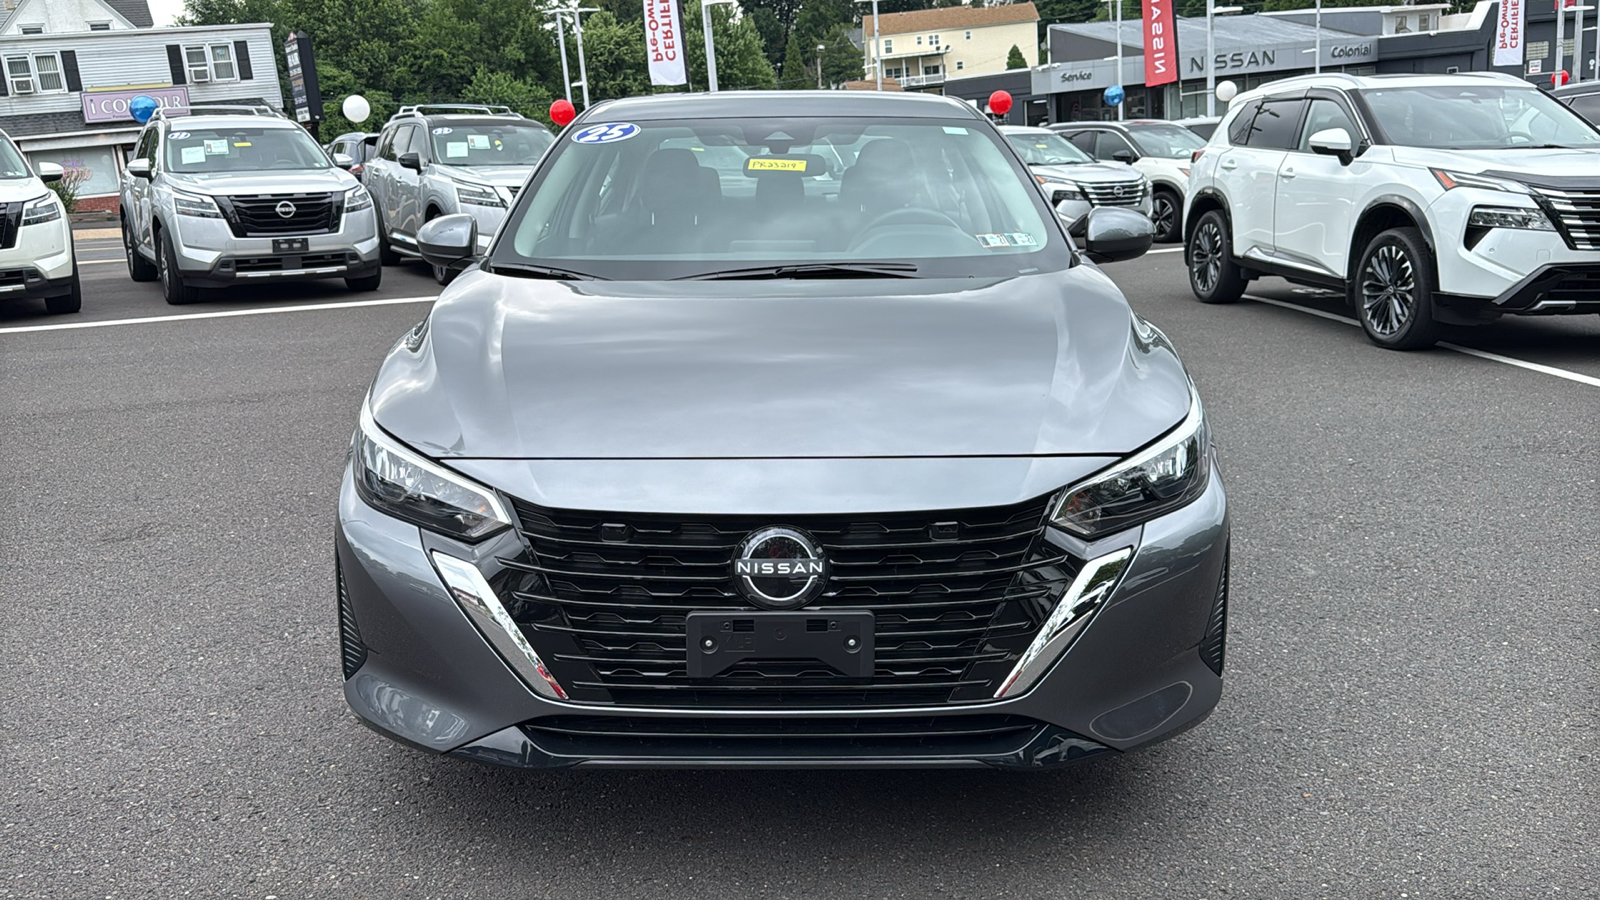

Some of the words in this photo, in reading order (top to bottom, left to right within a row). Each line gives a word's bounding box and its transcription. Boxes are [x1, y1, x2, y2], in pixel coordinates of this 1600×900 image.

[1331, 43, 1372, 58] Colonial
[1189, 50, 1275, 73] NSSAN
[1061, 71, 1092, 83] Service
[580, 124, 632, 141] 25
[737, 562, 823, 574] NISSAN
